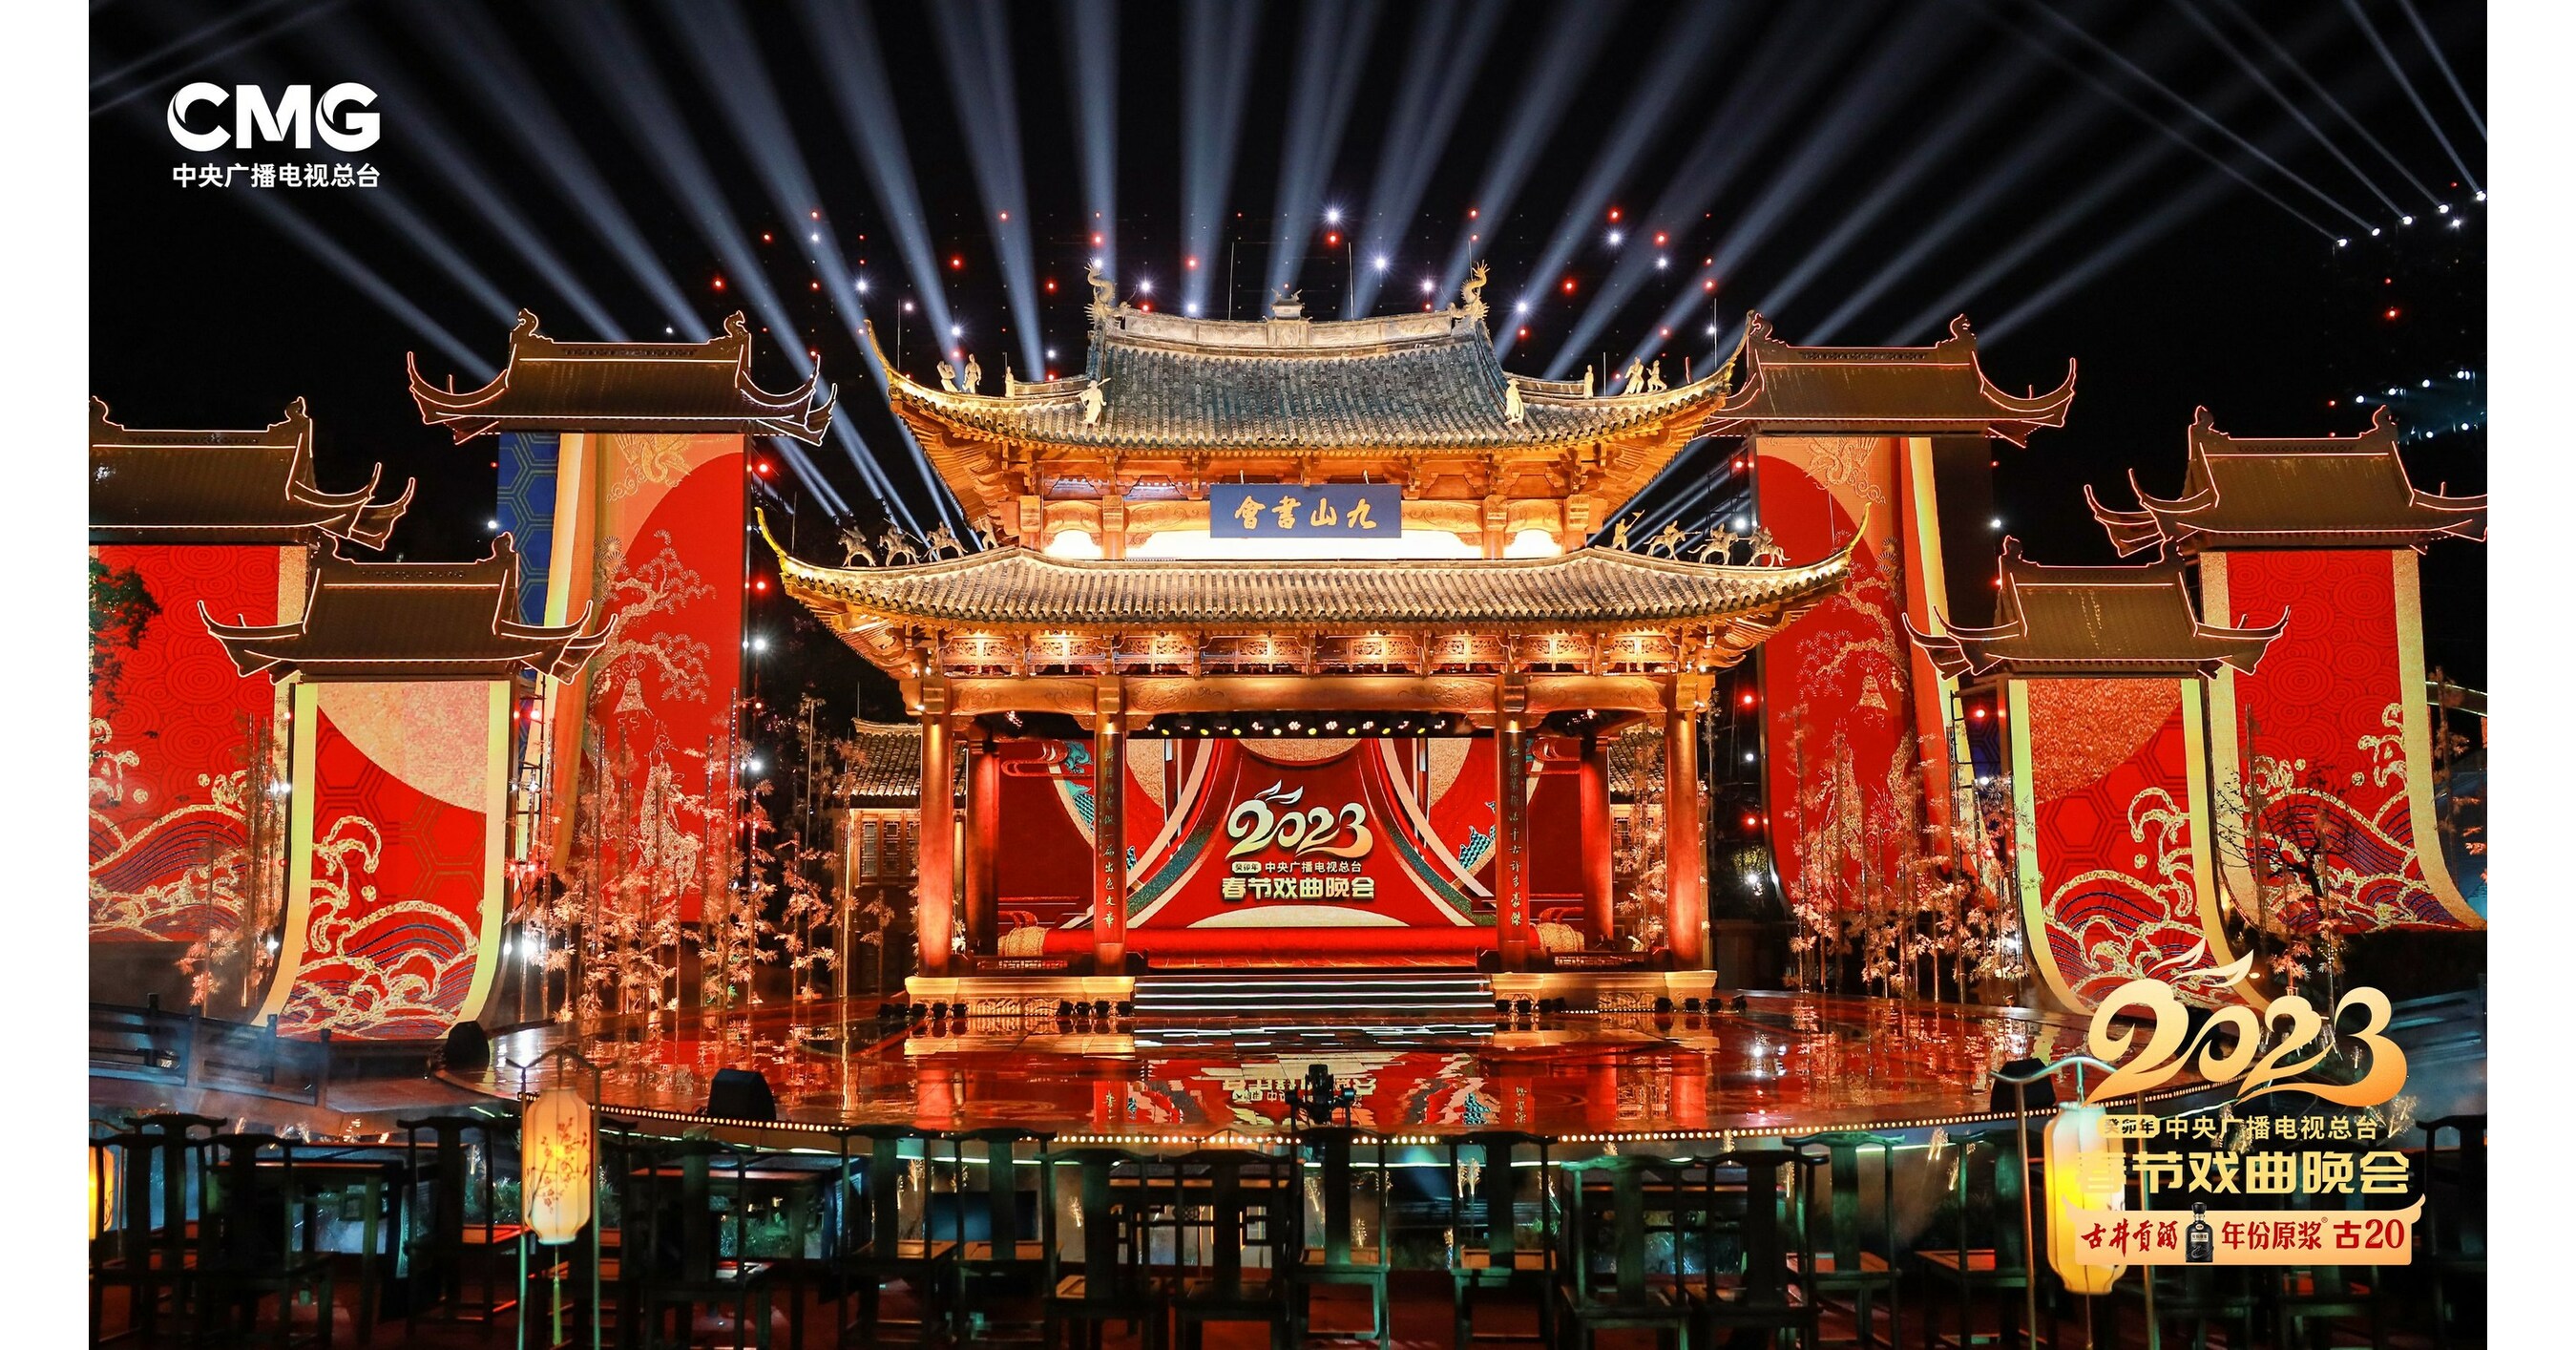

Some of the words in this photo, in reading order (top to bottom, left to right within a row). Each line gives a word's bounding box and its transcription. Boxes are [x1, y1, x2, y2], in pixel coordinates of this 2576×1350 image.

[1225, 799, 1373, 860] 2023
[1265, 861, 1362, 873] 中央广播电视总台
[1222, 877, 1374, 899] 春节戏曲晚会
